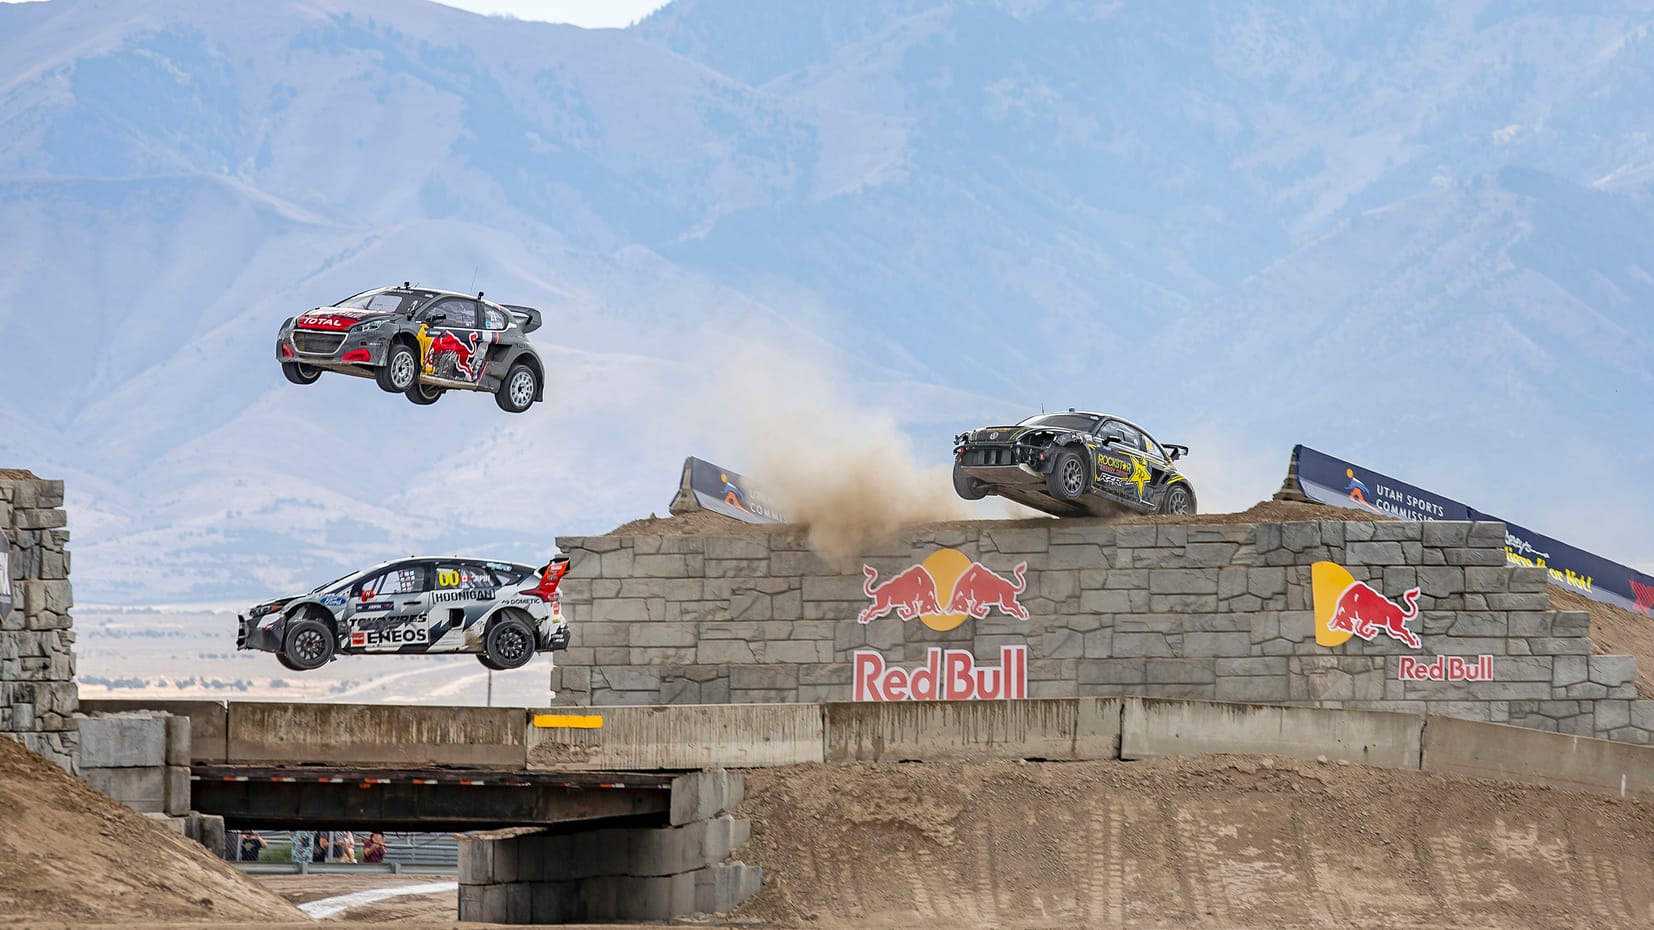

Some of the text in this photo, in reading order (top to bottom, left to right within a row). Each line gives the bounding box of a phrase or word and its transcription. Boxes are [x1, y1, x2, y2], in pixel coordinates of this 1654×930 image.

[303, 317, 342, 327] TOTAL
[1376, 483, 1444, 518] UTAH SPORTS
[438, 570, 460, 587] 00
[1549, 567, 1563, 582] or
[1565, 568, 1592, 593] Not!
[366, 628, 427, 644] ENEOS
[854, 645, 1028, 702] Red Bull
[1399, 655, 1494, 682] Red Bull
